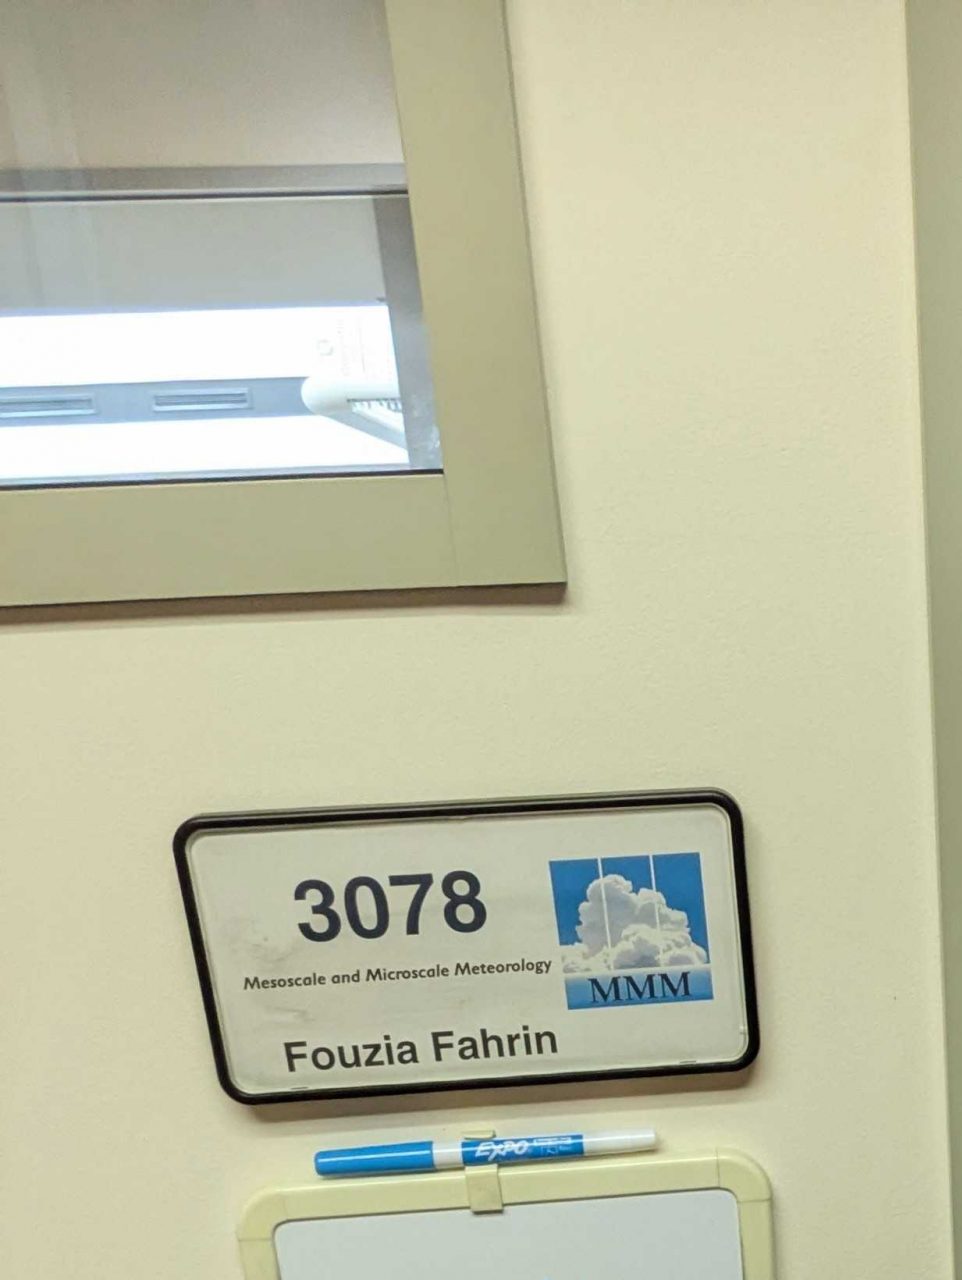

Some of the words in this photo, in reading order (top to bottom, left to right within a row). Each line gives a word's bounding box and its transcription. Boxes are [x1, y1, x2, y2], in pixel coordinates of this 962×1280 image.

[294, 870, 487, 942] 3078
[243, 972, 327, 990] Mesoscale
[331, 969, 361, 984] and
[366, 964, 450, 982] Microscale
[454, 958, 552, 975] Meteorology
[587, 971, 691, 1003] MMM
[283, 1034, 419, 1072] Fouzia
[431, 1025, 559, 1062] Fahrin
[475, 1140, 529, 1161] EXPO
